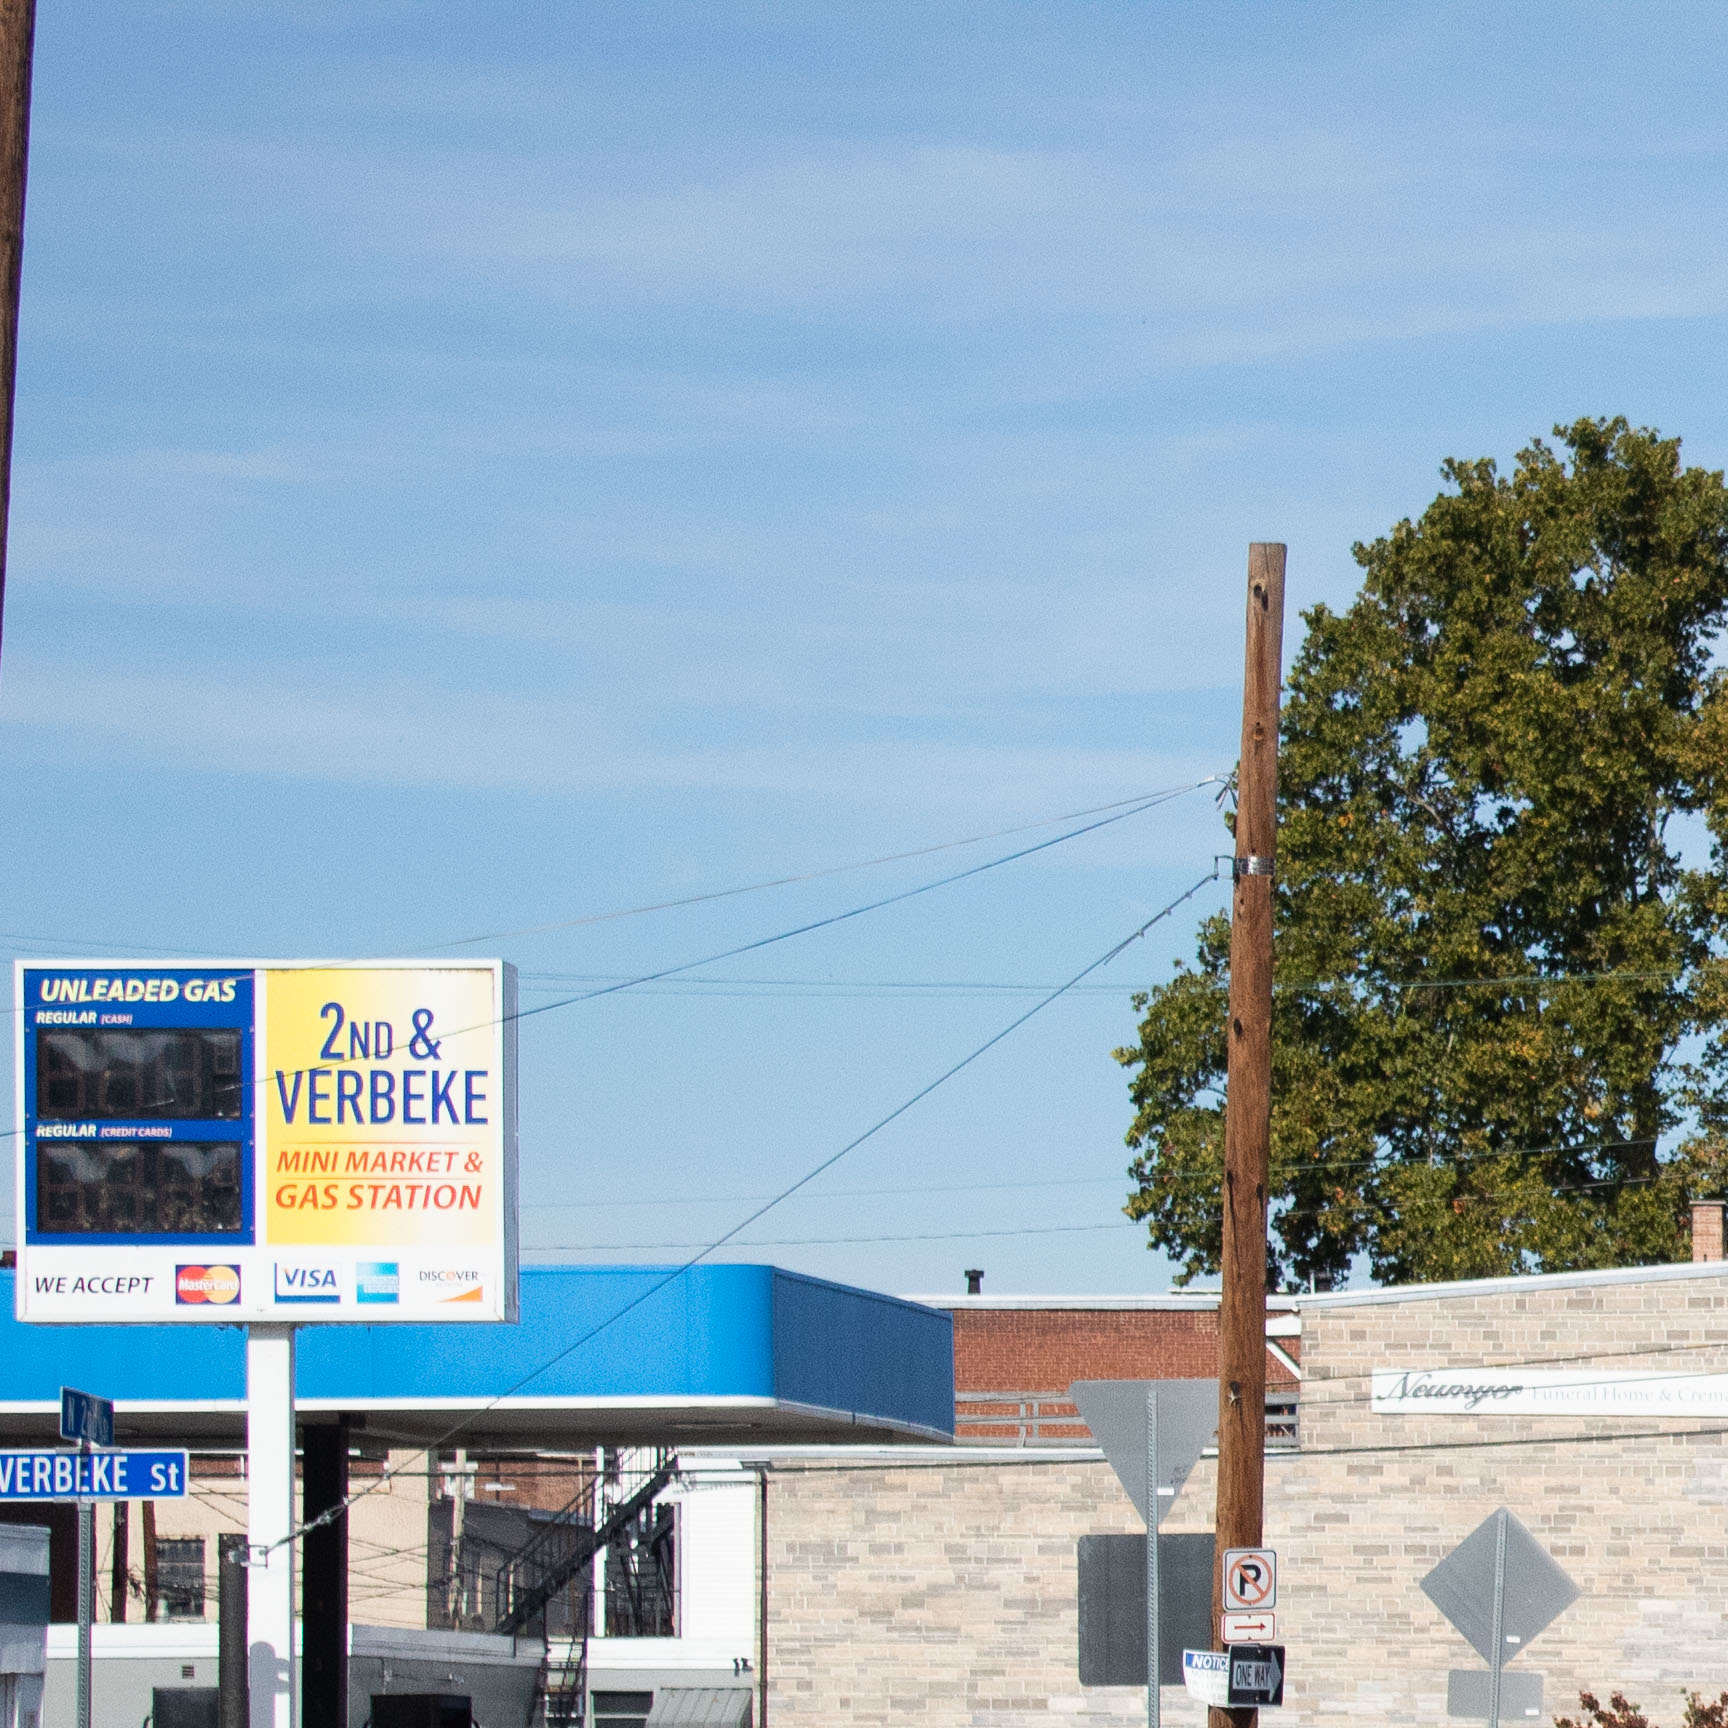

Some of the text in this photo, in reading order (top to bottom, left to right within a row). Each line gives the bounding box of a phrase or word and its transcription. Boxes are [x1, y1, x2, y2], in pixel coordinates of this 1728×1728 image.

[40, 978, 237, 1002] UNLEADED GAS
[36, 1011, 97, 1024] REGULAR
[320, 1002, 442, 1060] 2ND &
[275, 1070, 488, 1125] VERBEKE
[36, 1125, 97, 1137] REGULAR
[276, 1151, 483, 1173] MINI MARKET &
[275, 1184, 482, 1210] GAS STATION
[35, 1277, 154, 1293] WE ACCEPT
[178, 1276, 239, 1292] MasterCard
[284, 1268, 337, 1287] VISA
[419, 1271, 479, 1281] DISCOVER
[1531, 1386, 1596, 1401] Funeral
[1602, 1386, 1652, 1401] Home
[1658, 1388, 1671, 1401] &
[0, 1455, 179, 1493] VERBEKE St
[1192, 1654, 1228, 1670] NOTIC
[1236, 1664, 1271, 1686] ONE WAY
